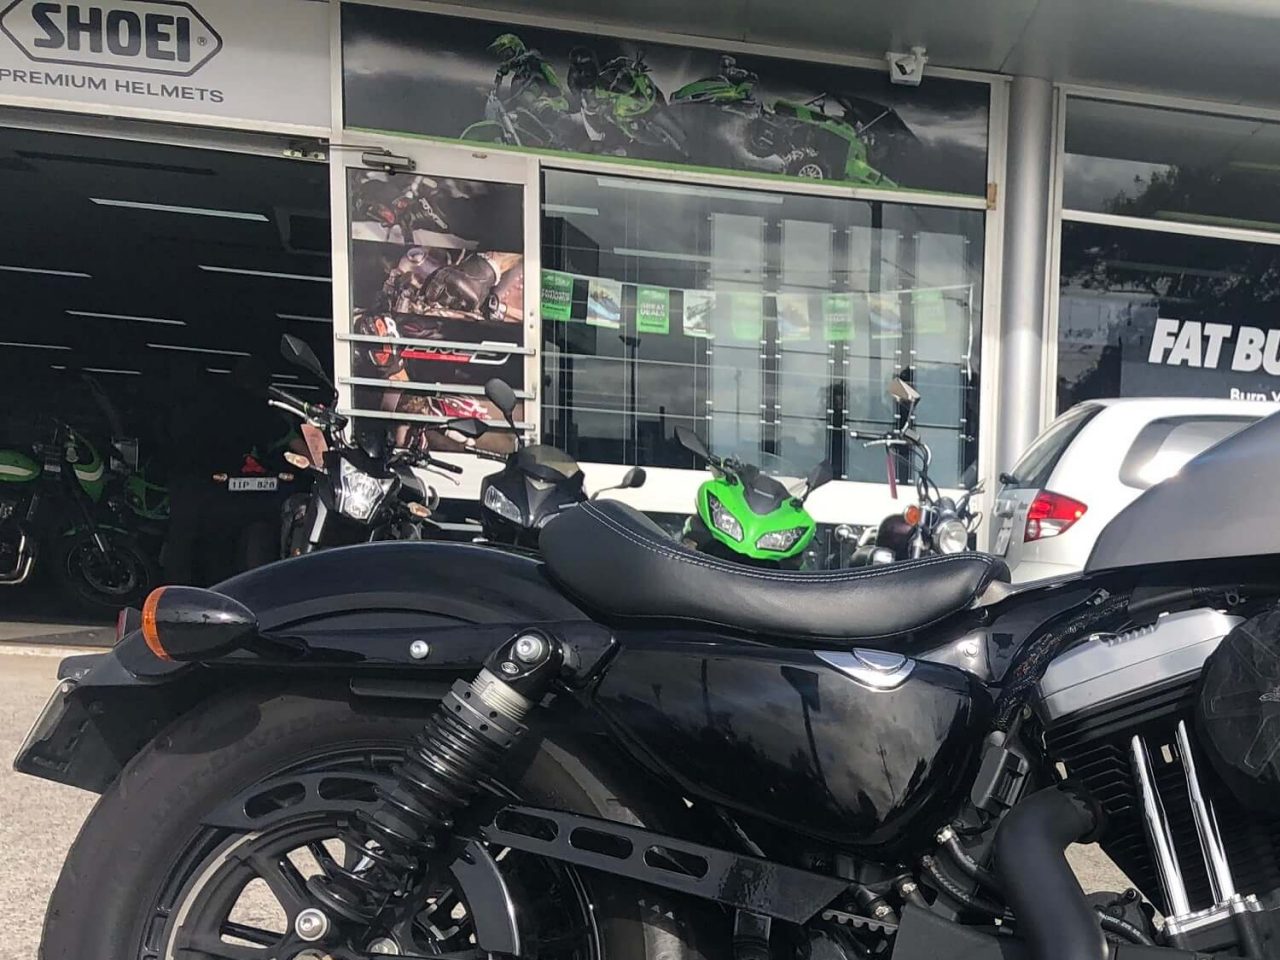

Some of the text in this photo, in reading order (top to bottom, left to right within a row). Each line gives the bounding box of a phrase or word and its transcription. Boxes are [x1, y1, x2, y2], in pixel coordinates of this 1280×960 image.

[31, 2, 191, 63] SHOEI
[0, 68, 225, 103] PREMIUM HELMETS
[1148, 318, 1232, 369] FAT
